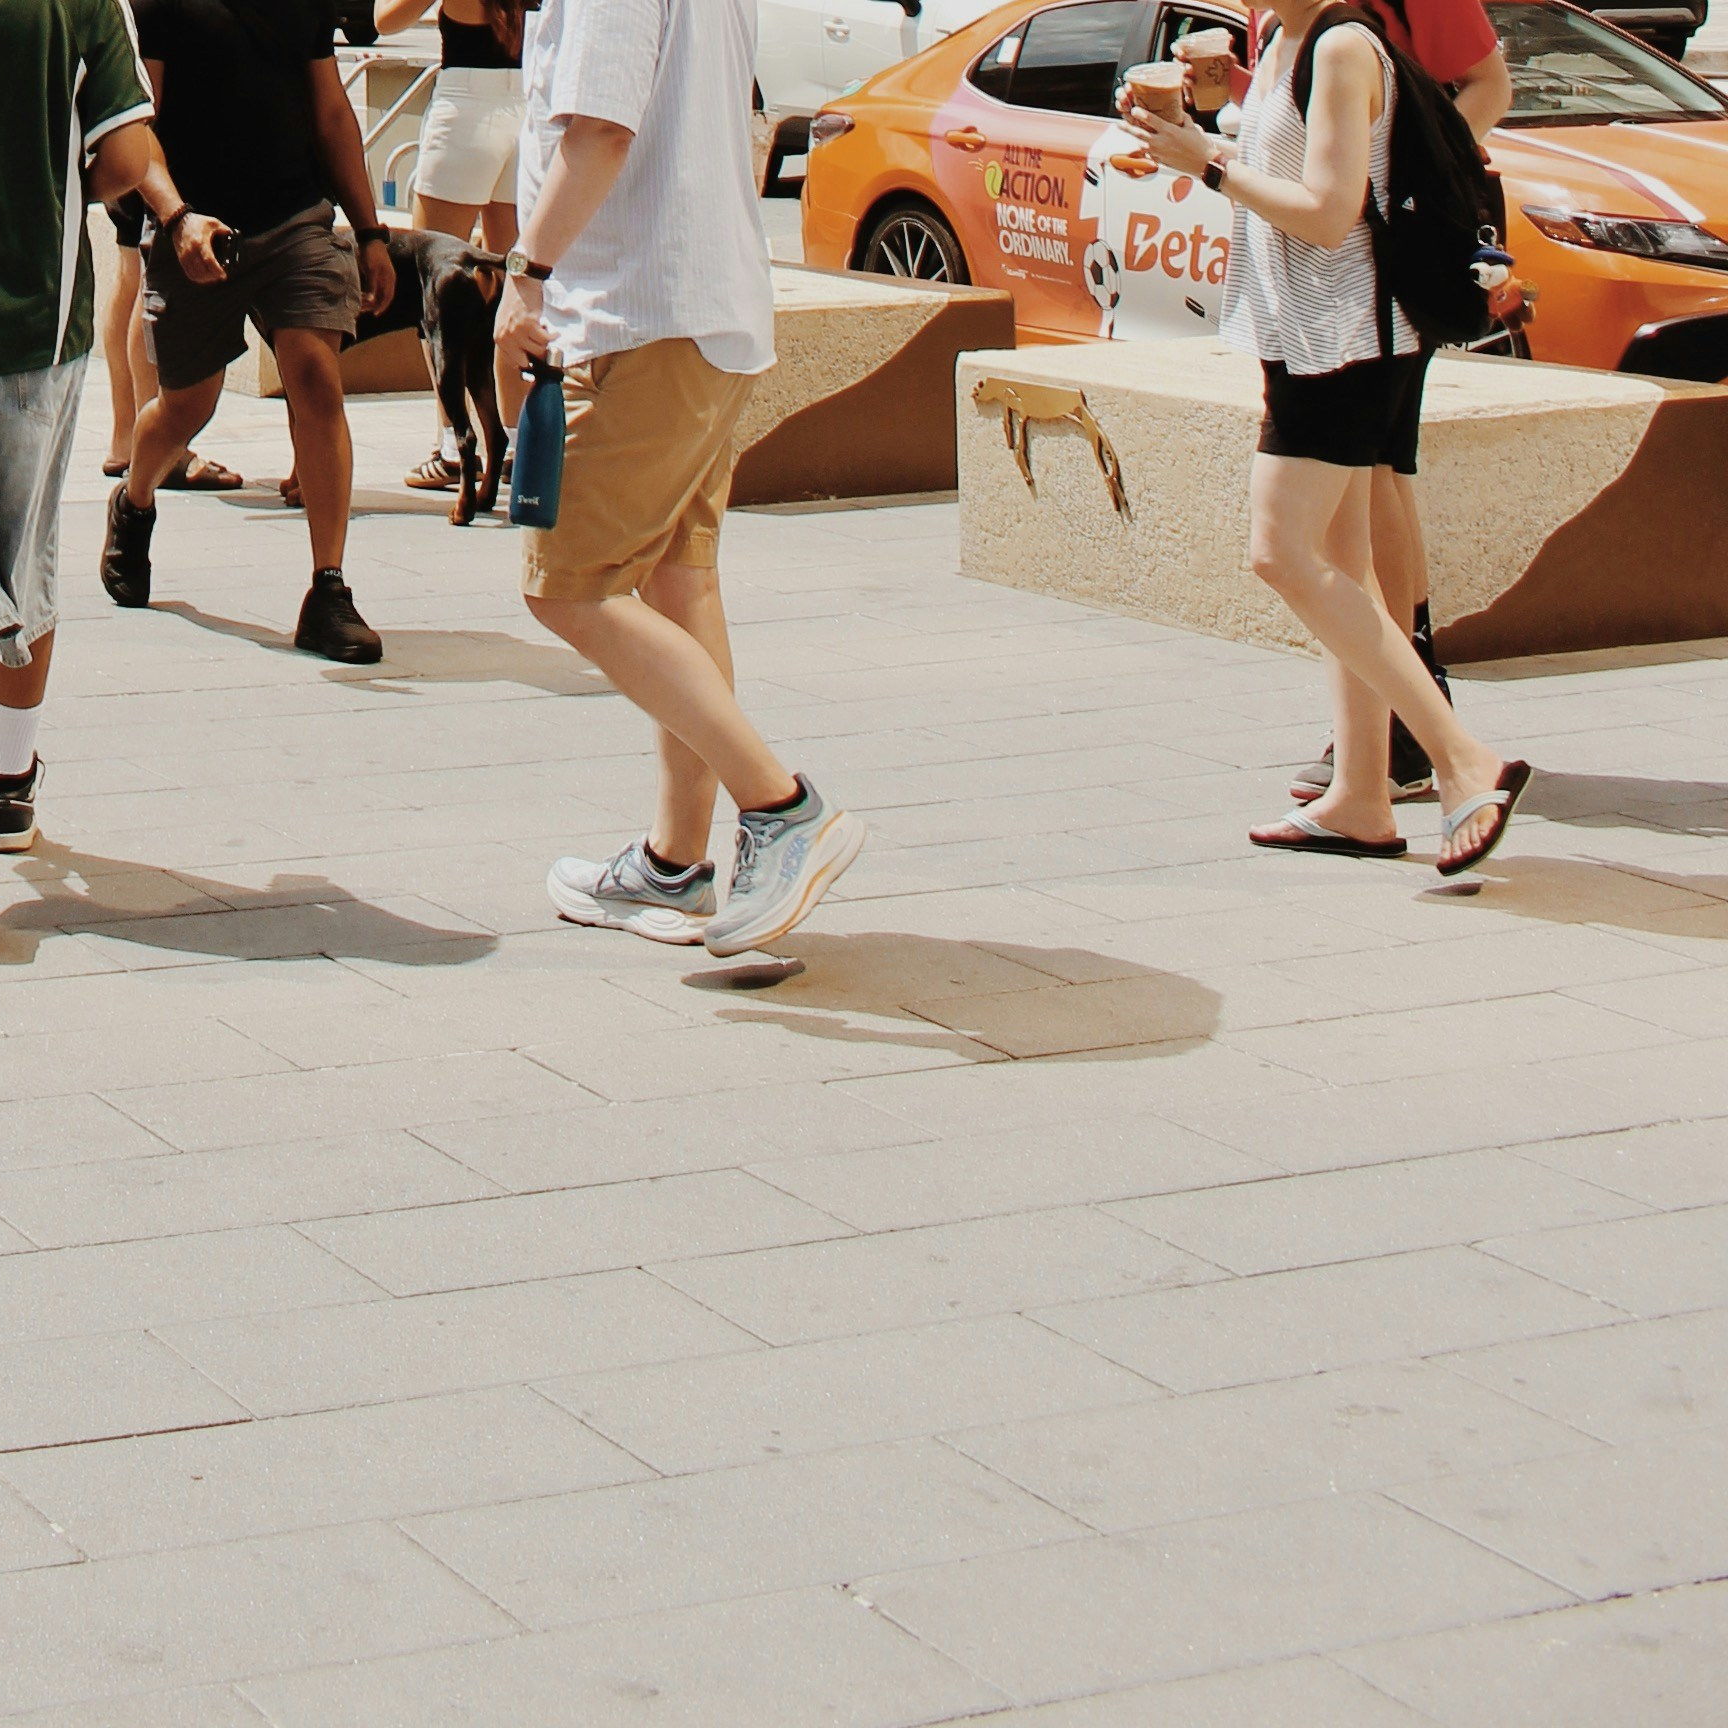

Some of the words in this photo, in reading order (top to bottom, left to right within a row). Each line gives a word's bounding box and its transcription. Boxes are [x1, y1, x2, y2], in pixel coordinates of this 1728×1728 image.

[1002, 144, 1020, 165] ALL
[1023, 146, 1043, 169] THE
[1000, 168, 1069, 209] ACTION.
[996, 202, 1037, 234] NONE
[1037, 214, 1052, 233] OF
[1051, 217, 1068, 237] THE
[999, 229, 1074, 266] ORDINARY.
